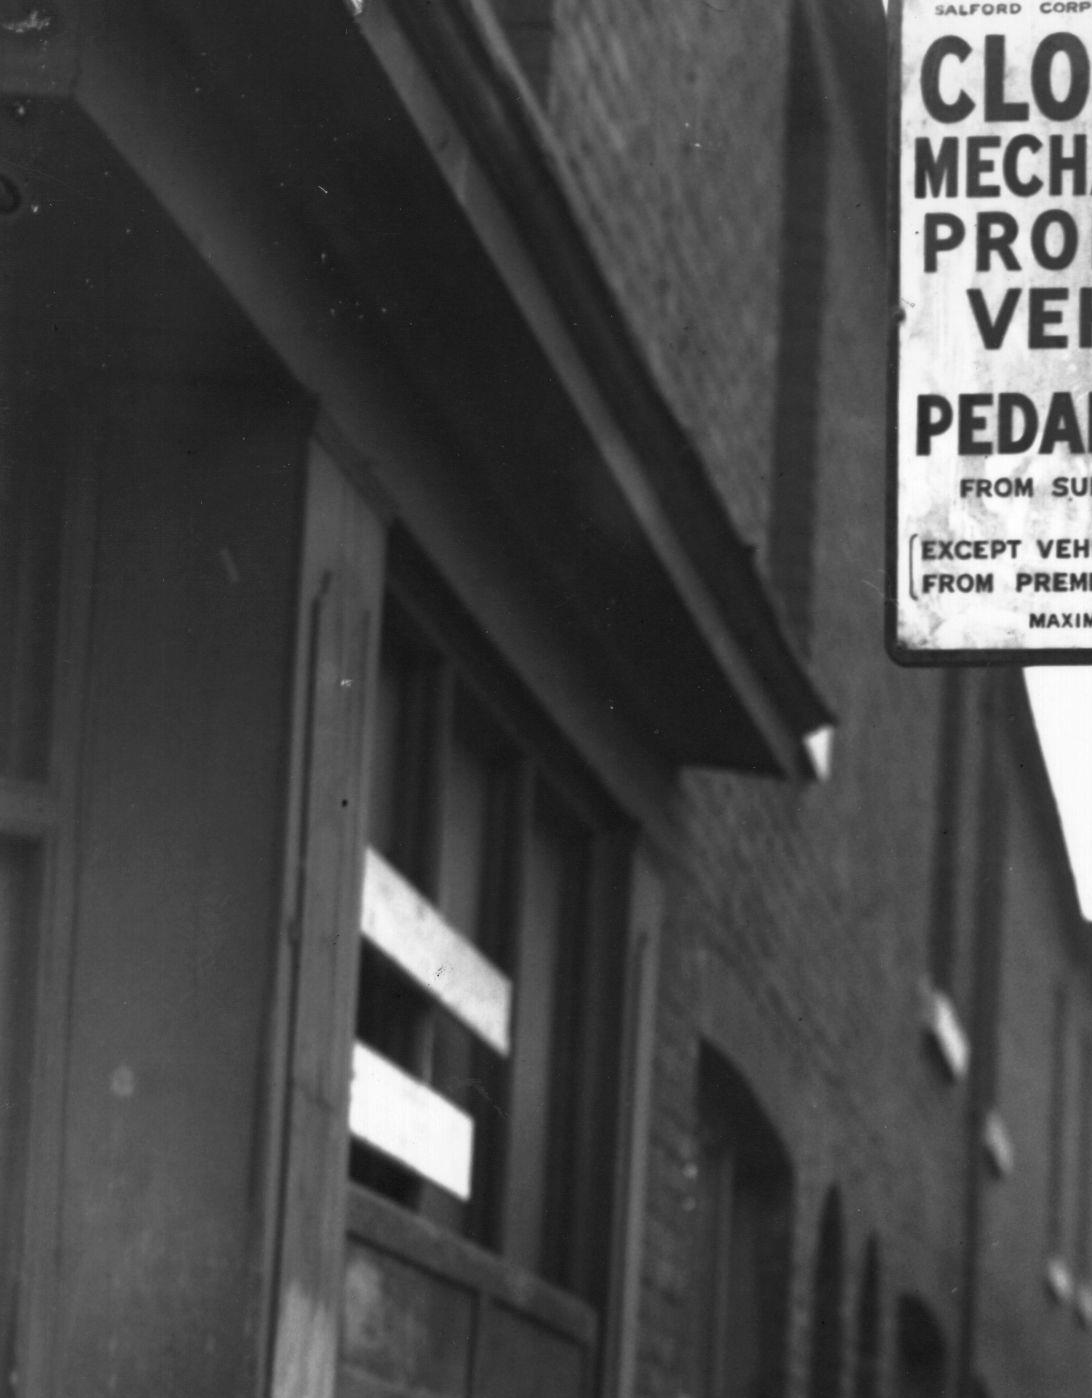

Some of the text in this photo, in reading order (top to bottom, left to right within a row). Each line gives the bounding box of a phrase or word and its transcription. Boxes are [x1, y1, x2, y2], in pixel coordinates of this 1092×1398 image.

[935, 2, 1022, 17] SALFORD
[960, 477, 1034, 499] FROM
[921, 539, 1022, 561] EXCEPT
[922, 573, 994, 594] FROM
